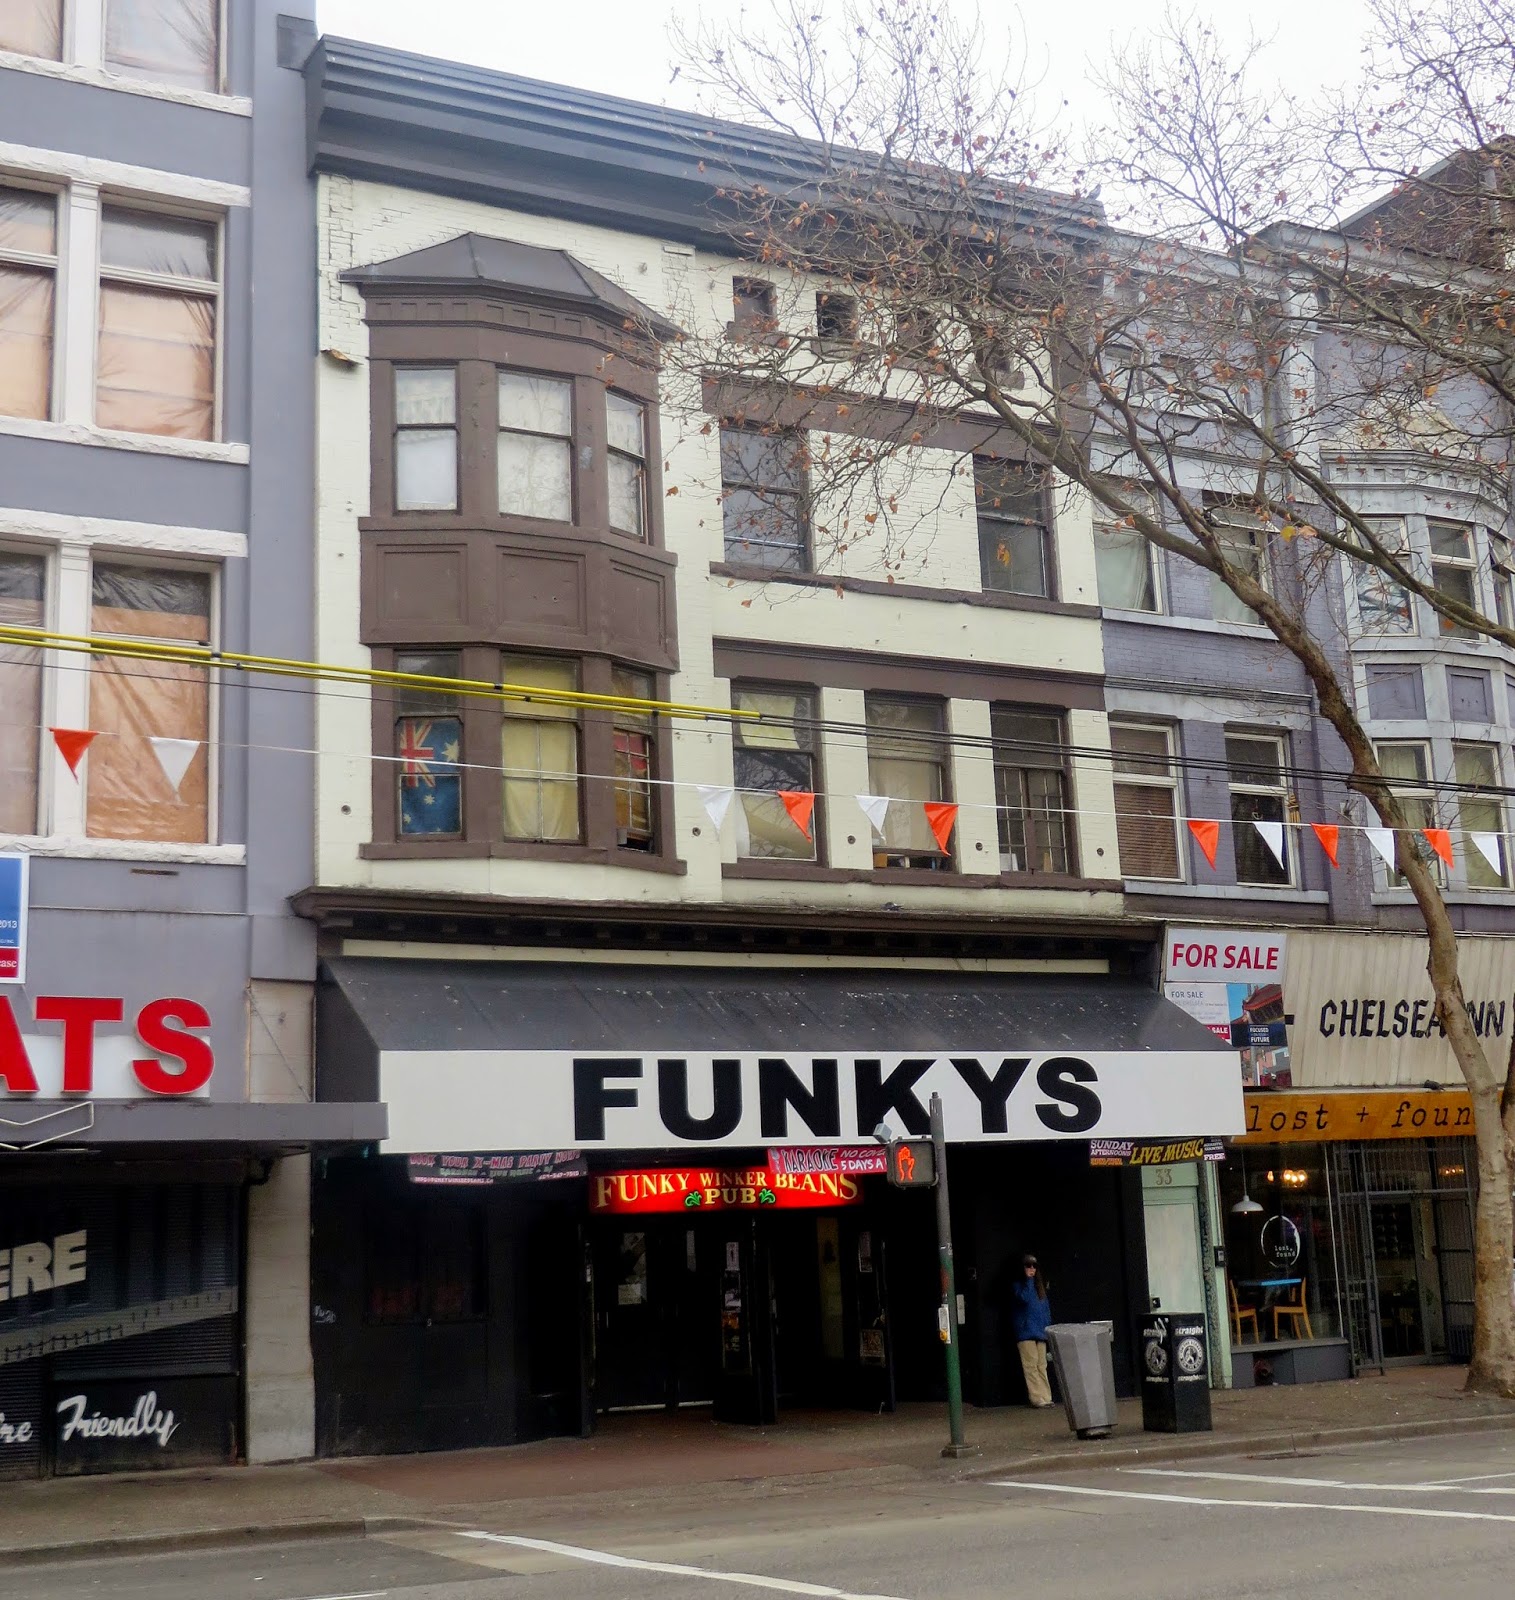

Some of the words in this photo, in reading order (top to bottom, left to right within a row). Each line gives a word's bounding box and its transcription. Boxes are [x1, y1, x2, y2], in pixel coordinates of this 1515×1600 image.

[0, 960, 17, 968] ase
[1172, 943, 1218, 968] FOR
[1223, 945, 1279, 970] SALE
[1466, 1000, 1505, 1038] NN
[573, 1057, 1102, 1141] FUNKYS
[1246, 1104, 1328, 1132] lost
[1392, 1101, 1470, 1128] foun
[840, 1149, 859, 1158] NO
[1090, 1140, 1134, 1150] SUNDAY
[1129, 1146, 1164, 1165] LIVE
[1162, 1138, 1205, 1162] MUSIC
[441, 1155, 469, 1169] YOUR
[472, 1156, 514, 1169] X-MAS
[518, 1152, 554, 1168] PARTY
[781, 1149, 838, 1173] KARAOKE
[841, 1160, 847, 1171] 5
[848, 1159, 874, 1171] DAYS
[875, 1158, 884, 1170] A
[1155, 1168, 1173, 1186] 33
[594, 1172, 690, 1209] FUNKY
[699, 1171, 768, 1187] WINKER
[775, 1173, 858, 1200] BEANS
[704, 1188, 757, 1206] PUB
[57, 1390, 181, 1447] Friendly
